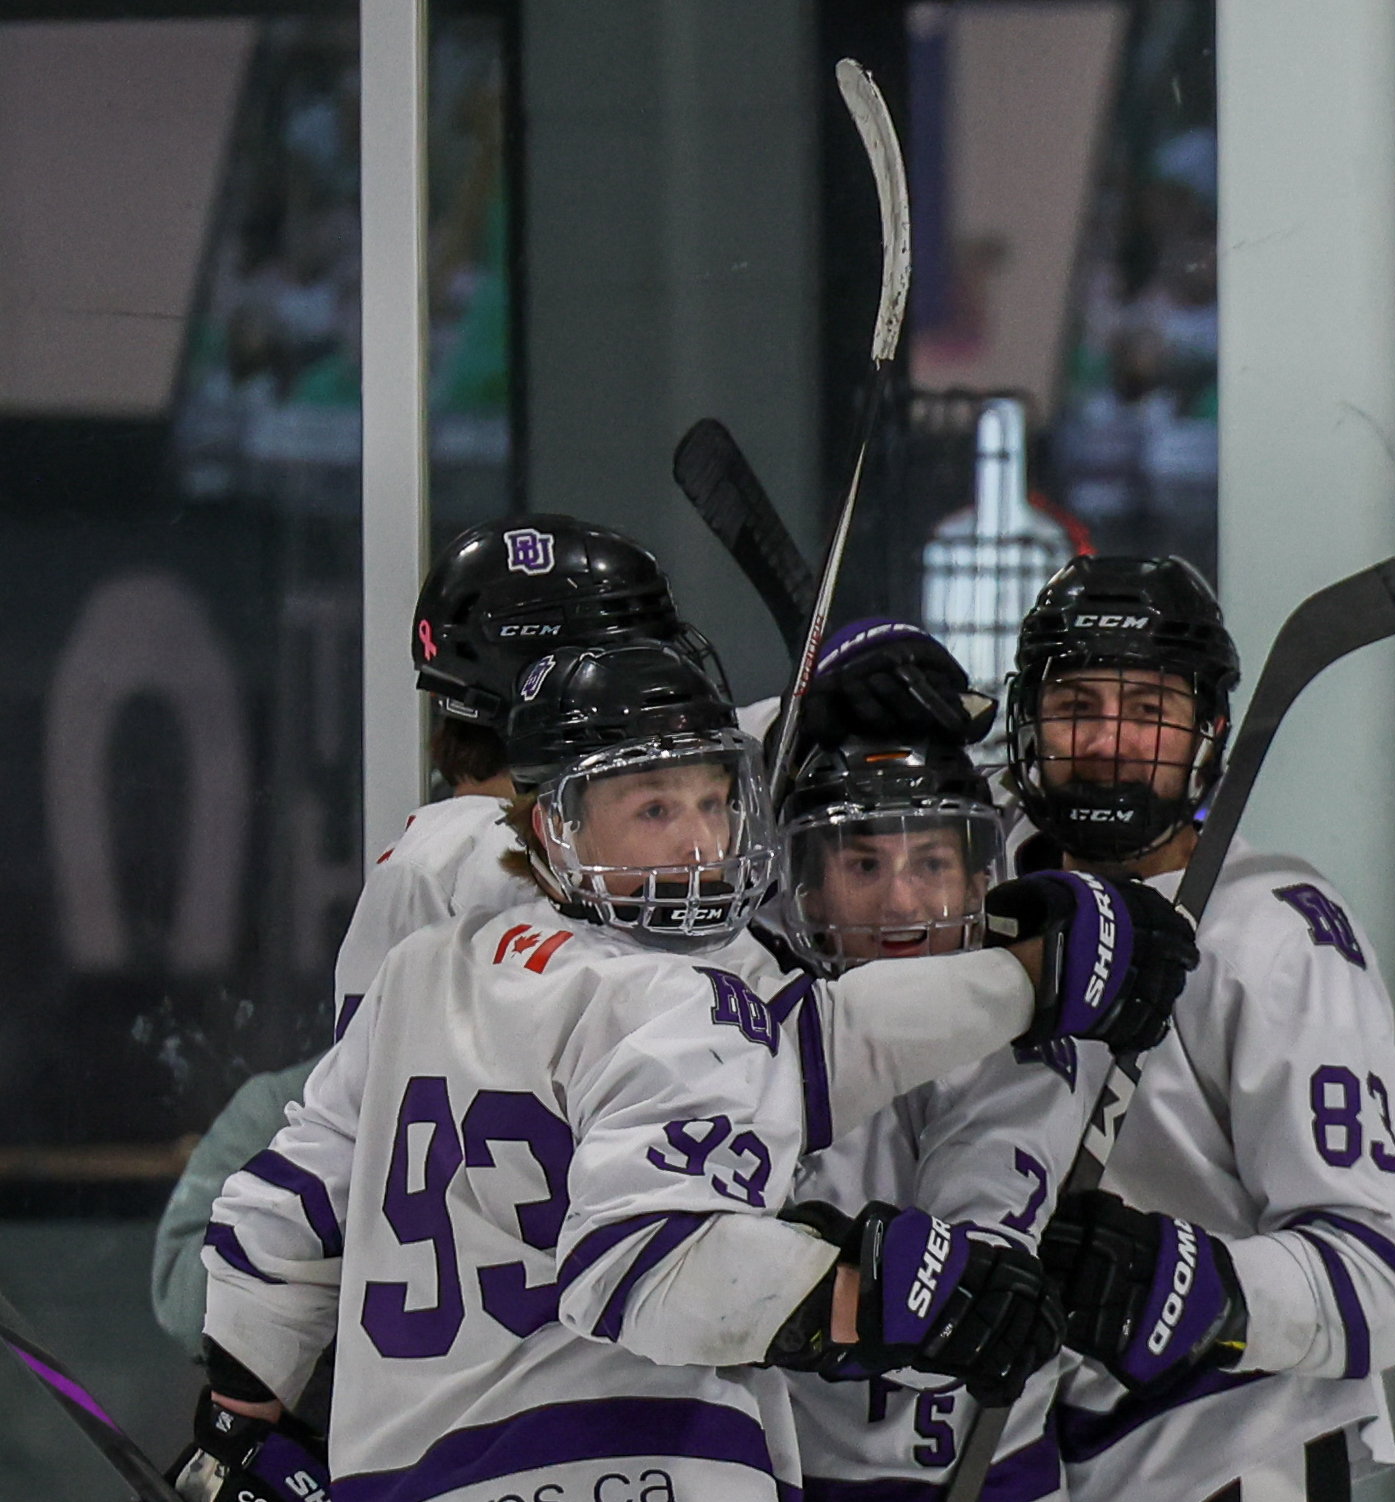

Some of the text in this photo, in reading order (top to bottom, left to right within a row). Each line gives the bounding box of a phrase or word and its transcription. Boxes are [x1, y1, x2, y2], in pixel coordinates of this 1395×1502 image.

[1075, 614, 1149, 629] CCM
[501, 624, 562, 636] CCM
[1071, 807, 1134, 823] CCM
[646, 1115, 773, 1208] 93
[361, 1076, 574, 1358] 93
